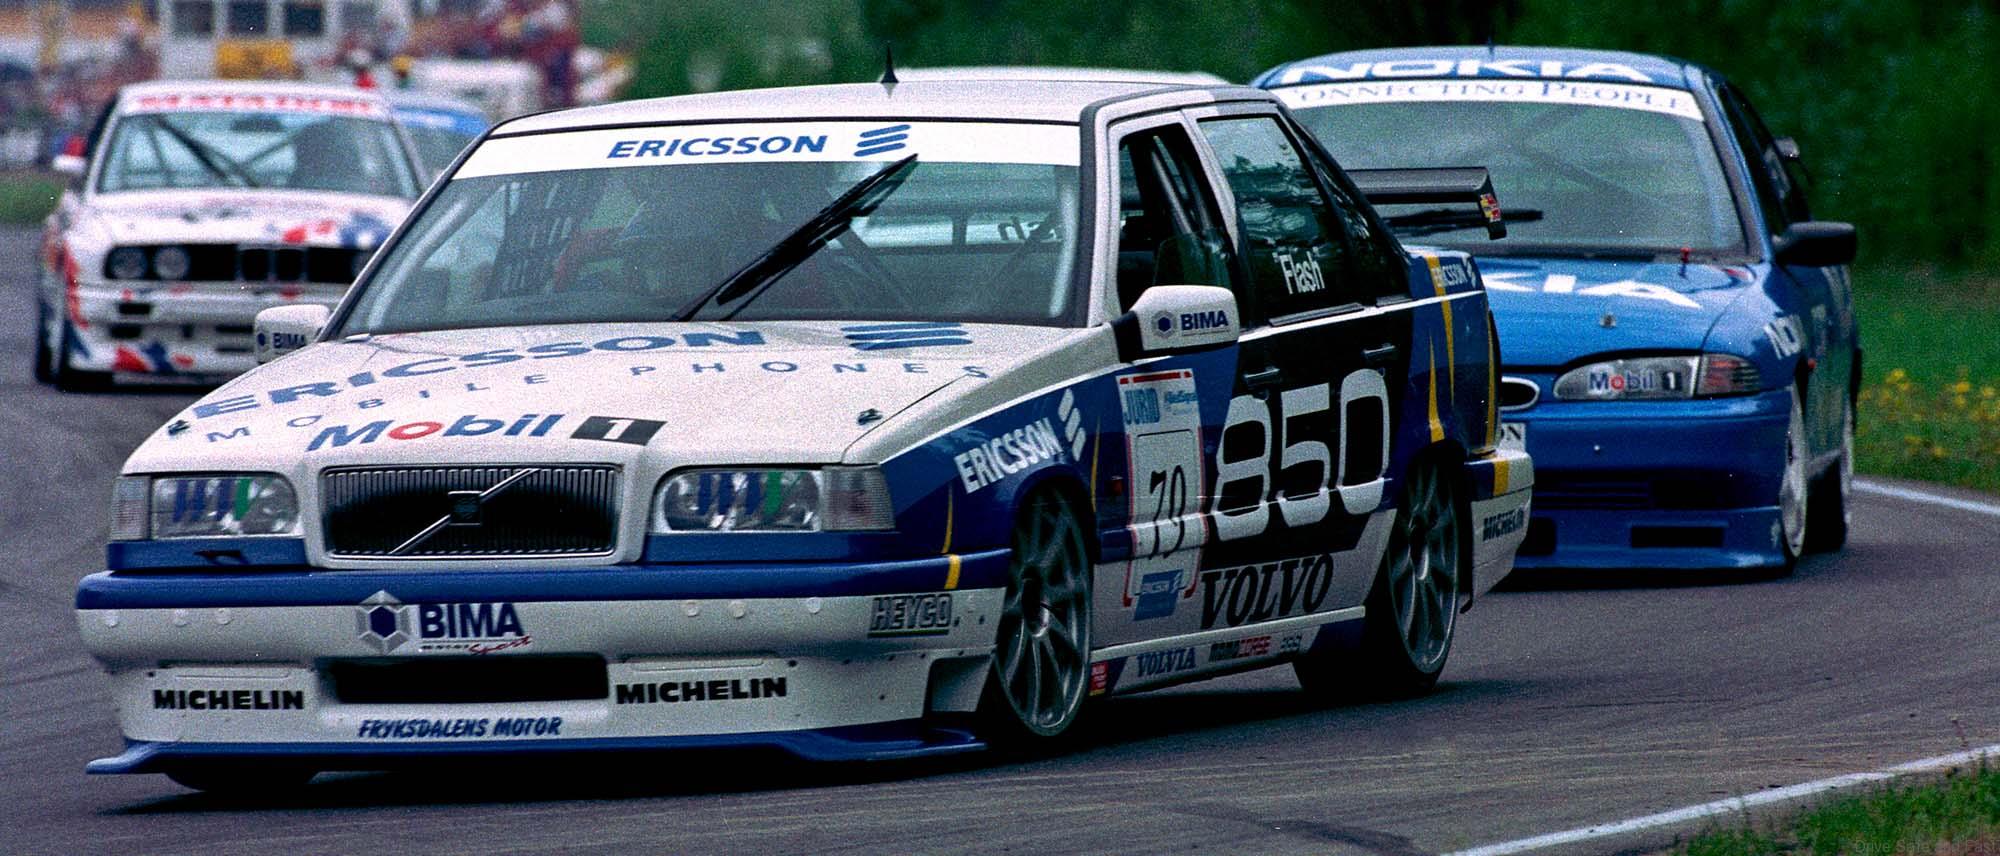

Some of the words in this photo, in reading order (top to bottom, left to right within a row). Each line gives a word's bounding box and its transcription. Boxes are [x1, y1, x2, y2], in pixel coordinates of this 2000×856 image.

[1281, 59, 1653, 84] NOKIA
[1298, 83, 1526, 101] ONNECTING
[1540, 81, 1690, 112] PEOPLE
[606, 134, 828, 160] ERICSSON
[1430, 263, 1468, 288] ERICSSON
[1180, 310, 1229, 331] BIMA
[272, 332, 307, 350] BIMA
[192, 330, 766, 419] ERICSSON
[1588, 368, 1655, 391] Mobil
[1667, 371, 1676, 390] 1
[206, 373, 550, 443] MOBILE
[629, 359, 990, 379] PHONES
[306, 414, 565, 451] Mobil
[952, 416, 1063, 495] ERICSSON
[1210, 367, 1391, 542] 850
[1482, 508, 1525, 542] MICHELIN
[1201, 552, 1335, 630] VOLVO
[419, 602, 526, 639] BIMA
[869, 592, 953, 631] HEYCO
[1136, 647, 1197, 678] VOLVIA
[153, 689, 305, 711] MICHELIN
[616, 676, 787, 705] MICHELIN
[358, 718, 489, 738] FRYKSDALENS
[493, 716, 563, 737] MOTOR
